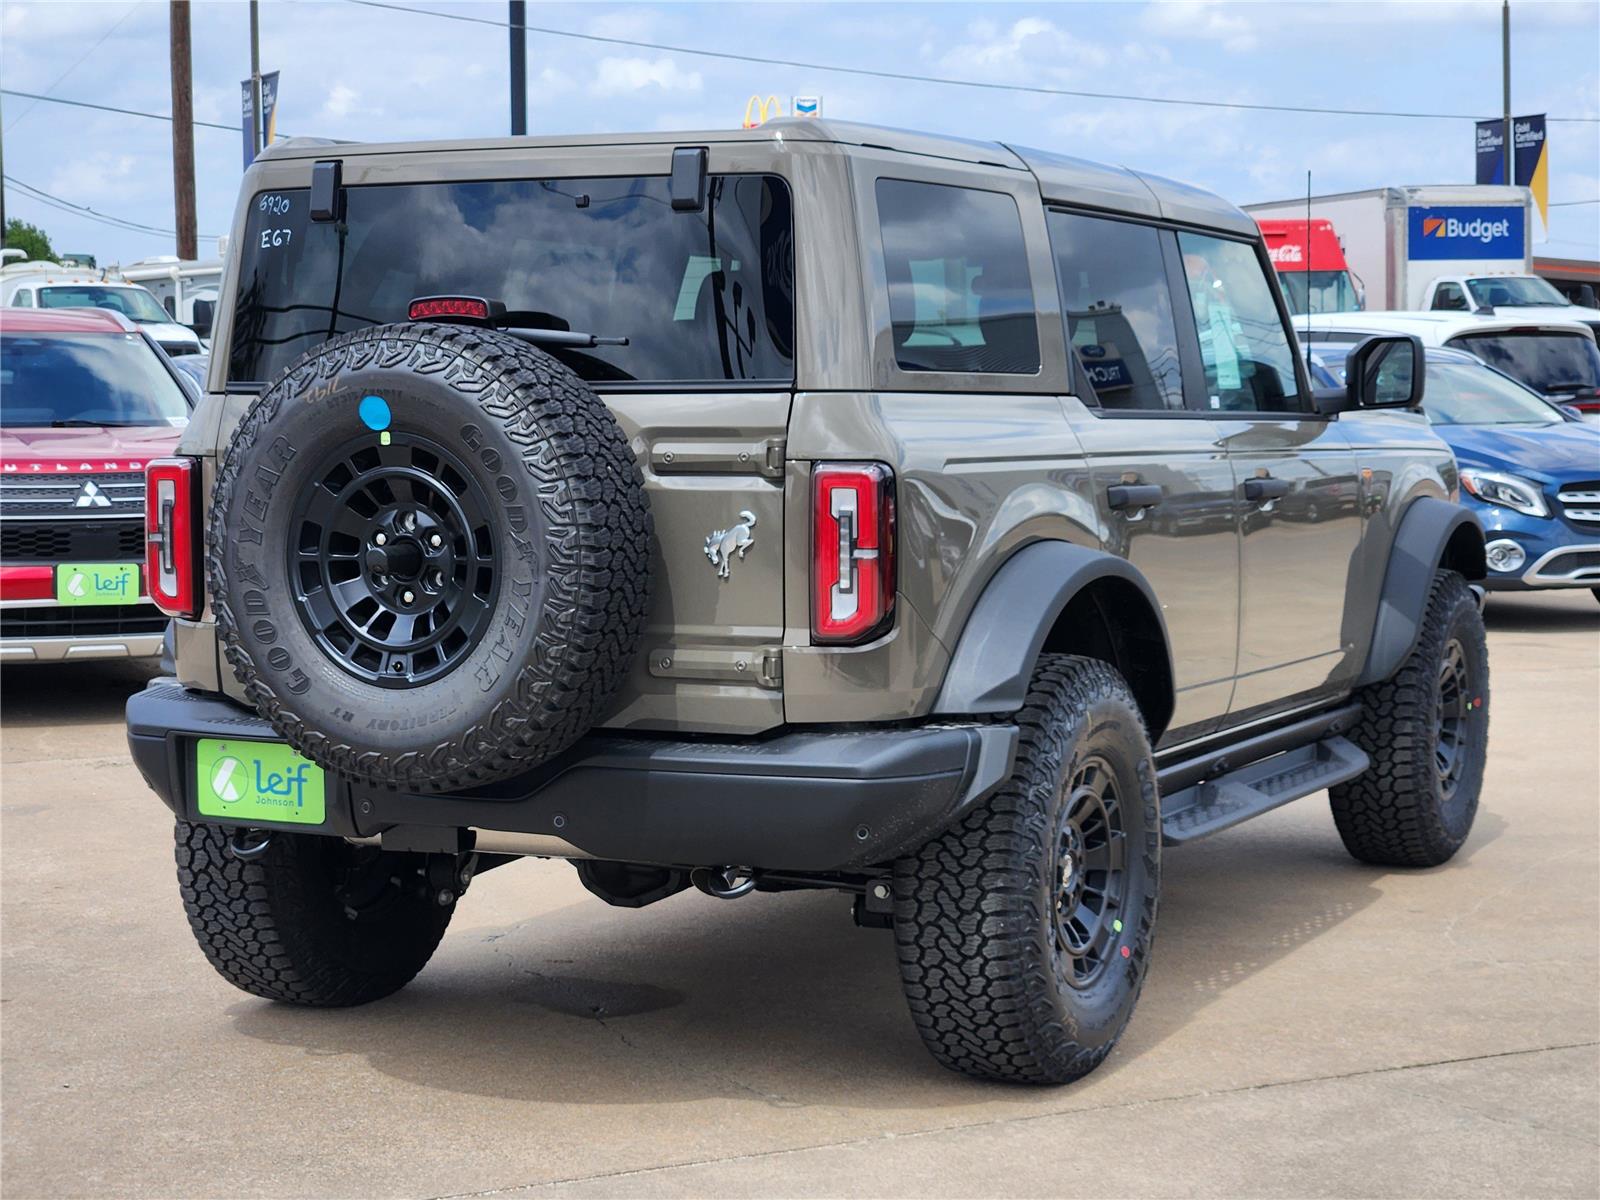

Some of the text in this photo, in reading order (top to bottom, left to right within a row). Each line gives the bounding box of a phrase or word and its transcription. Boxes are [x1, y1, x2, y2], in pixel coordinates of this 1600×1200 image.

[261, 228, 292, 249] E67
[1447, 218, 1510, 243] Budget
[233, 433, 312, 696] GOODYEAR
[255, 795, 295, 807] Johnson
